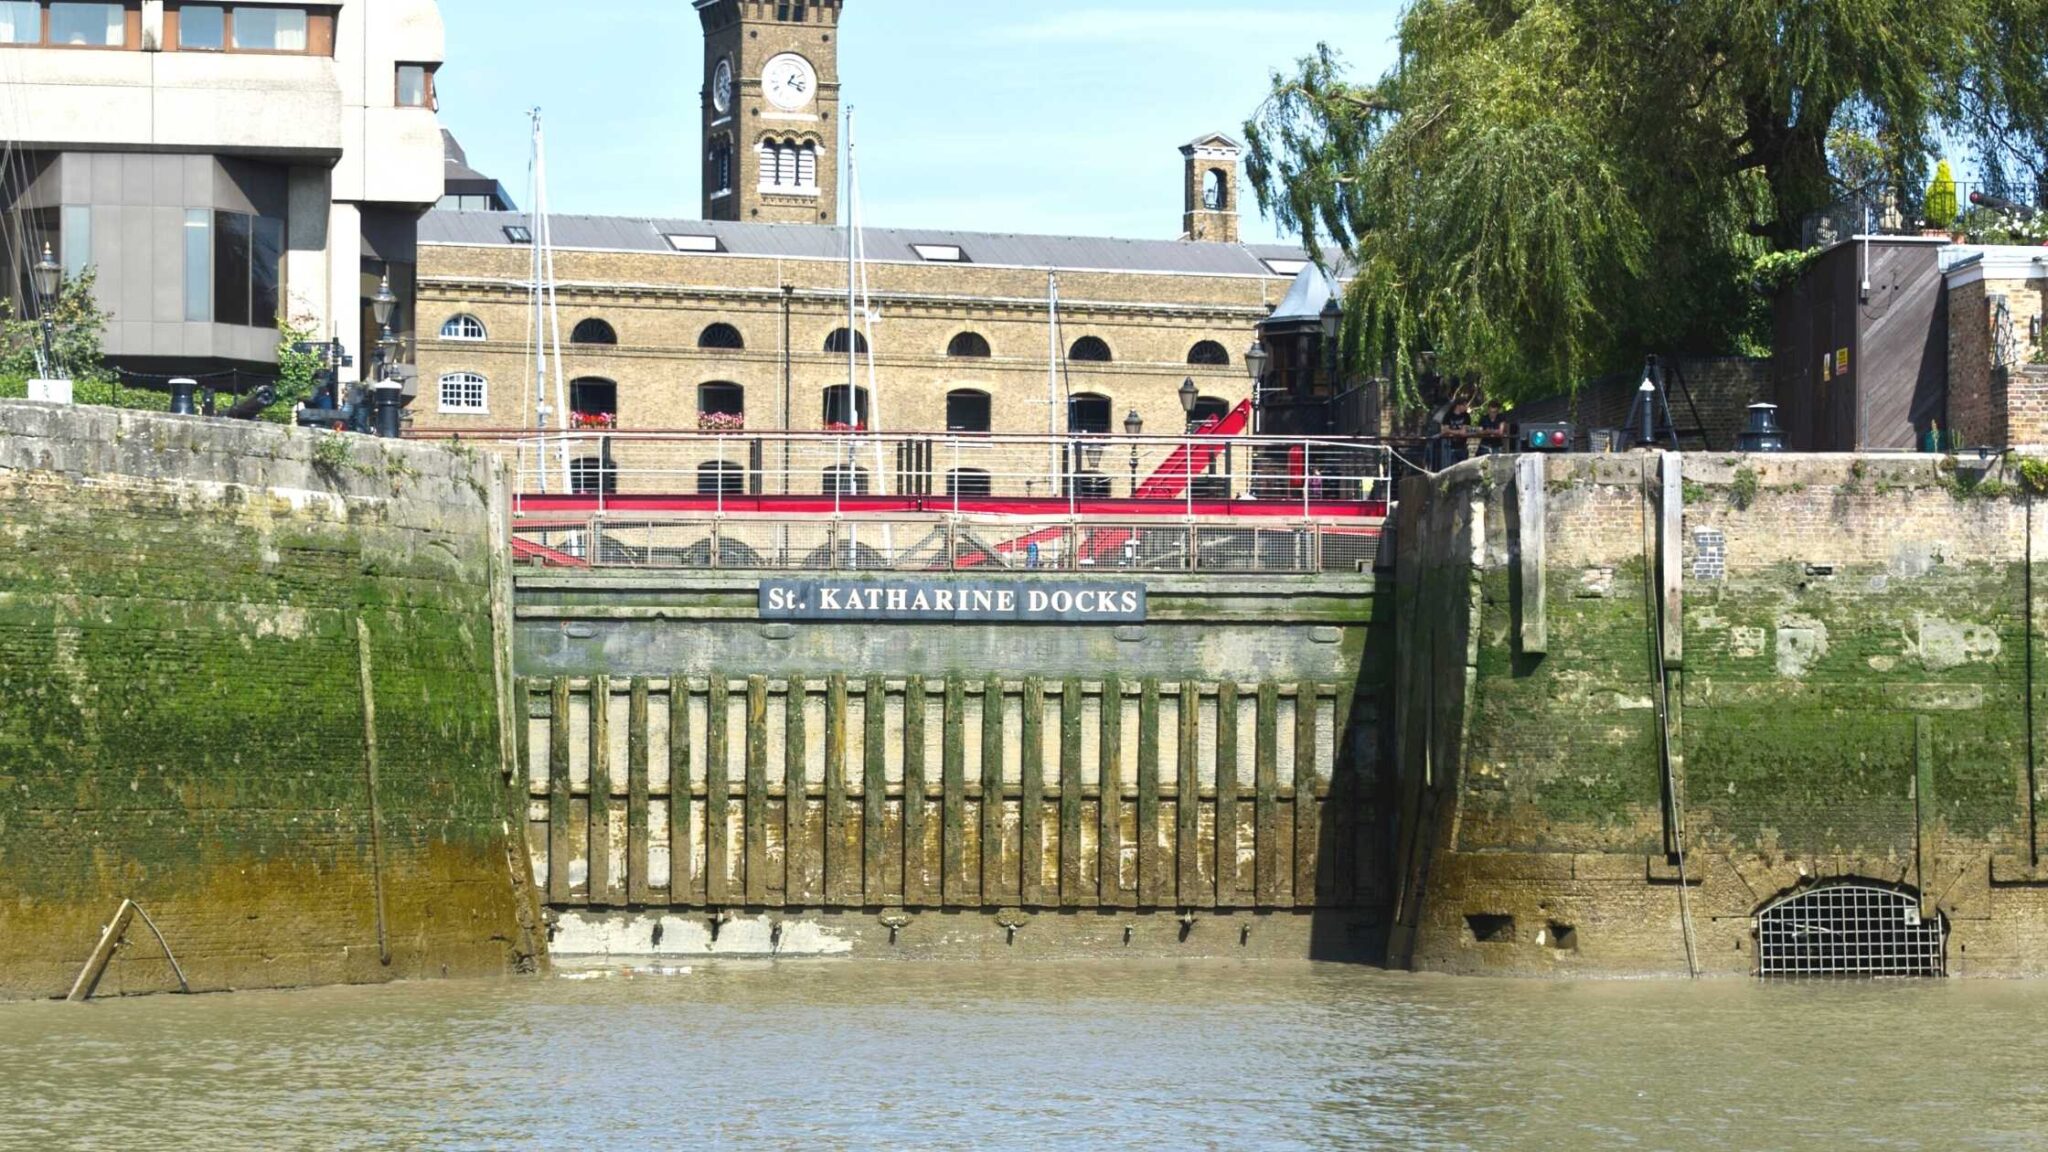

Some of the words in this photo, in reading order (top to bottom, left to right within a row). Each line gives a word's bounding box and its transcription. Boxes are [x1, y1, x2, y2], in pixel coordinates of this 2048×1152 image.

[768, 588, 804, 610] St.
[819, 588, 1015, 611] KATHARINE
[1029, 590, 1137, 612] DOCKS
